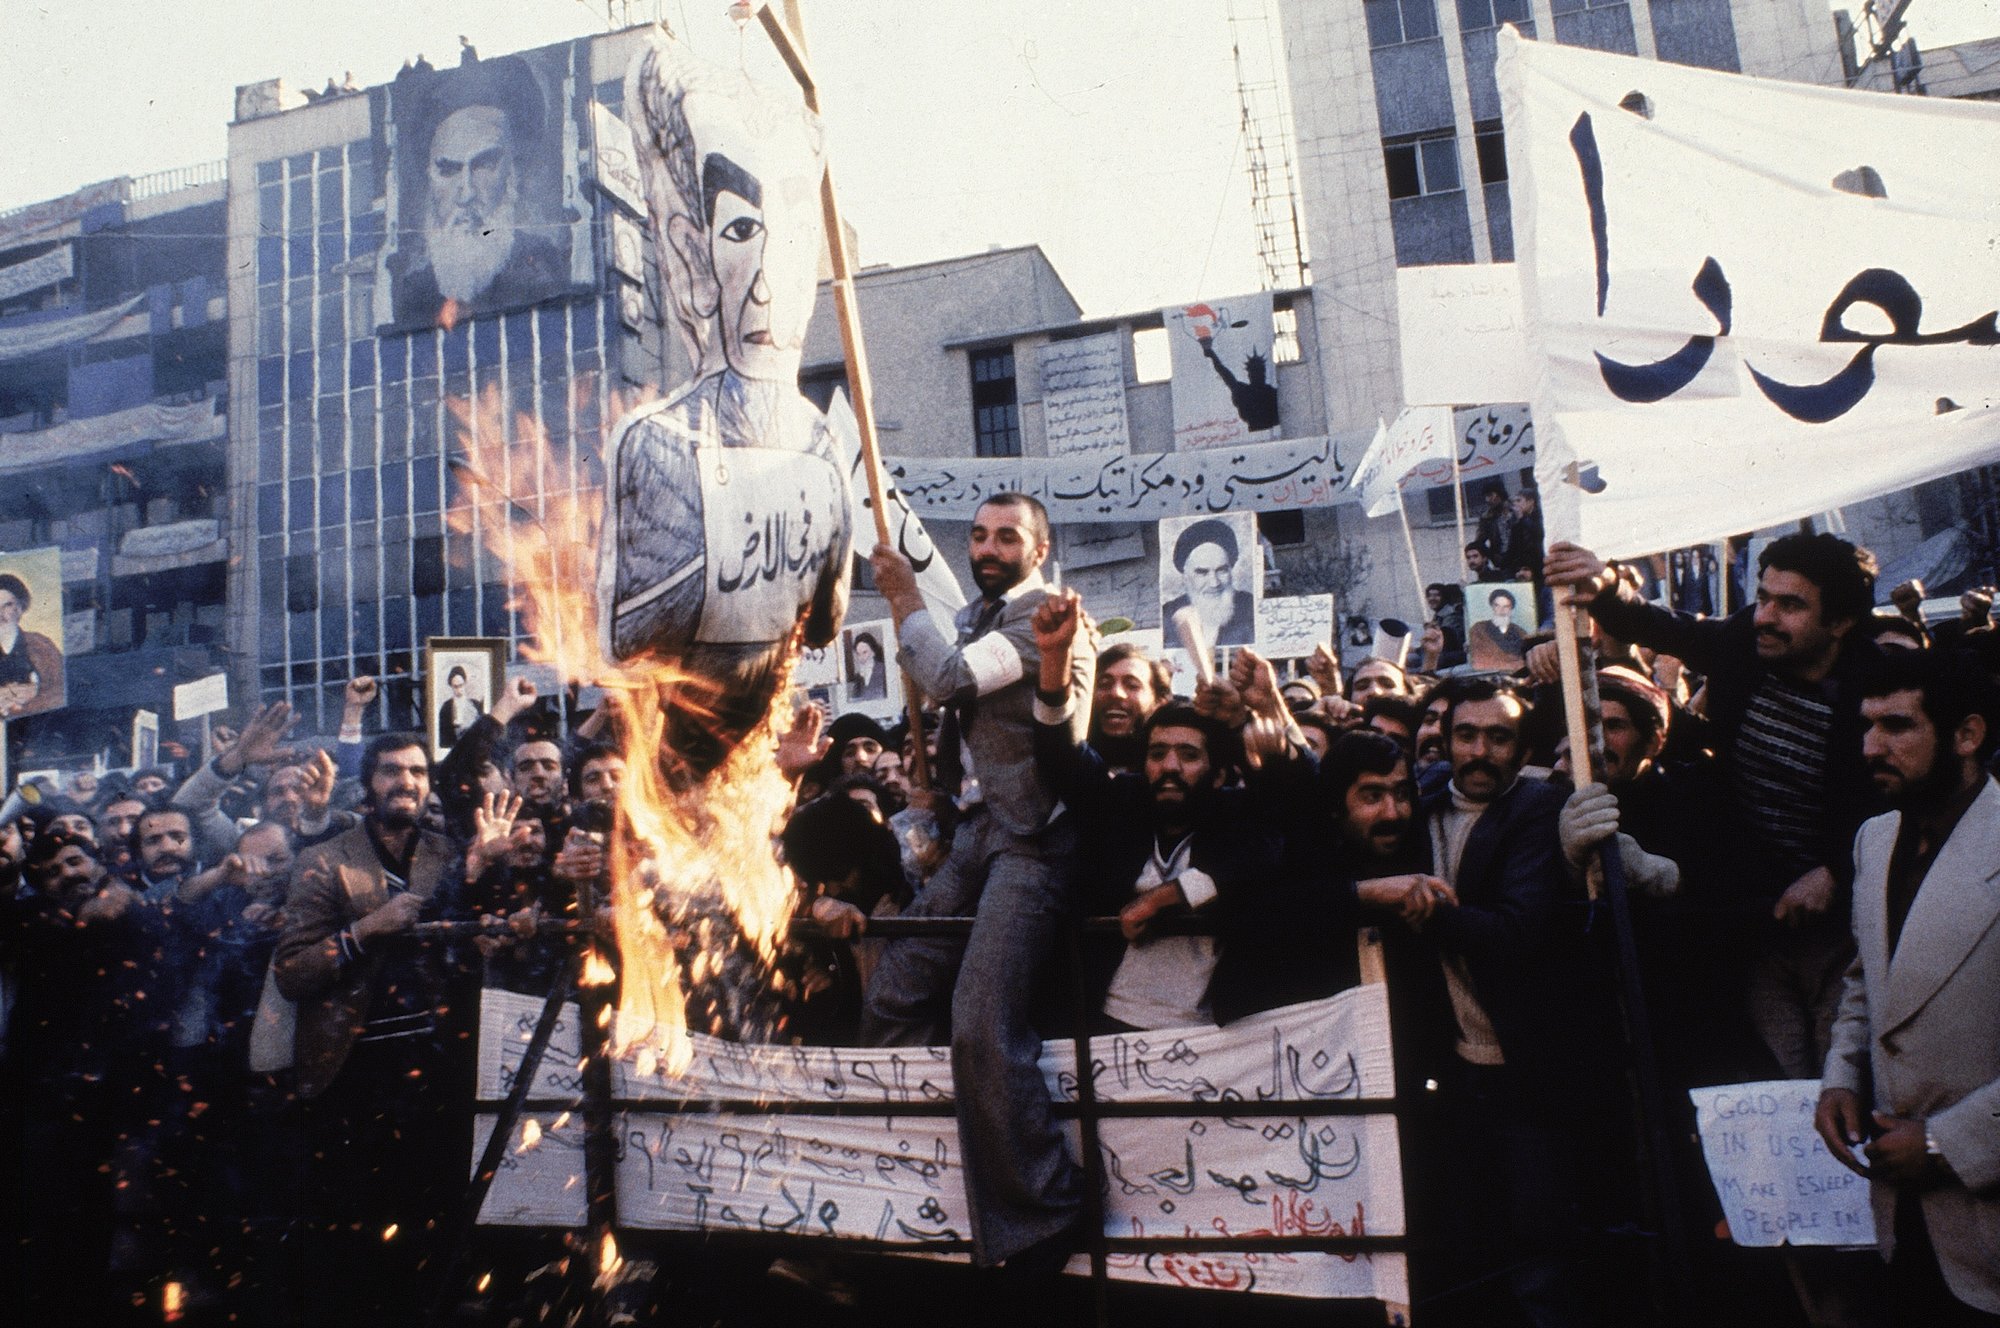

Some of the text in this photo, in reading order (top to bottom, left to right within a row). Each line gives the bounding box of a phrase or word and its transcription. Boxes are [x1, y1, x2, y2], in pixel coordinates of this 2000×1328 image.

[1721, 1132, 1746, 1155] IN
[1742, 1208, 1860, 1237] PEOPLE IN
